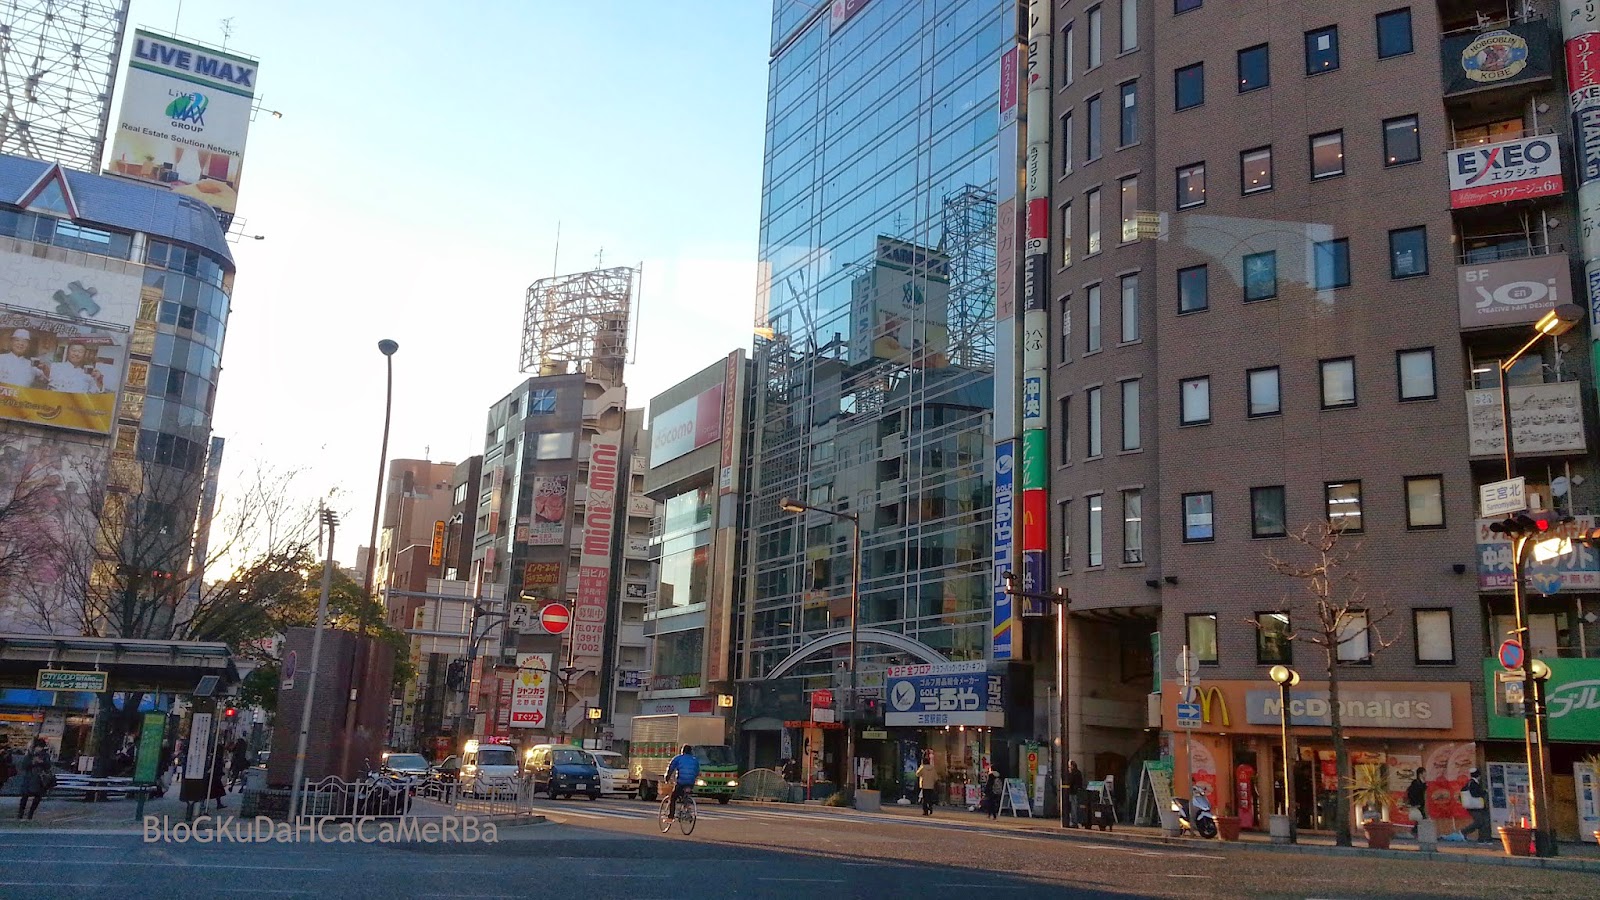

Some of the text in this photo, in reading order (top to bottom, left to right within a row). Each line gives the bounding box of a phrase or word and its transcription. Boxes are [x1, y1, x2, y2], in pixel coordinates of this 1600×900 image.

[1470, 36, 1517, 53] HOBGOBLIN
[194, 57, 254, 87] MAX
[1480, 68, 1512, 79] KOBE
[1571, 86, 1600, 109] EXE
[171, 120, 204, 133] GROUP
[121, 122, 241, 158] Real Estate Solution Network
[1457, 140, 1552, 185] EXEO
[1491, 166, 1540, 181] エクシオ
[1465, 269, 1489, 282] 5F
[1027, 379, 1040, 417] 中央
[653, 420, 694, 449] docomo
[590, 444, 618, 491] mini
[995, 485, 1013, 494] GOLF
[1485, 484, 1521, 502] 三宮北
[585, 506, 613, 556] mini
[581, 567, 607, 578] 当ビル
[576, 633, 601, 643] (391)
[576, 643, 600, 652] 7002
[517, 687, 546, 695] ジャンカラ
[919, 688, 938, 697] GOLF
[919, 686, 980, 711] つるや
[517, 713, 539, 721] すぐソコ
